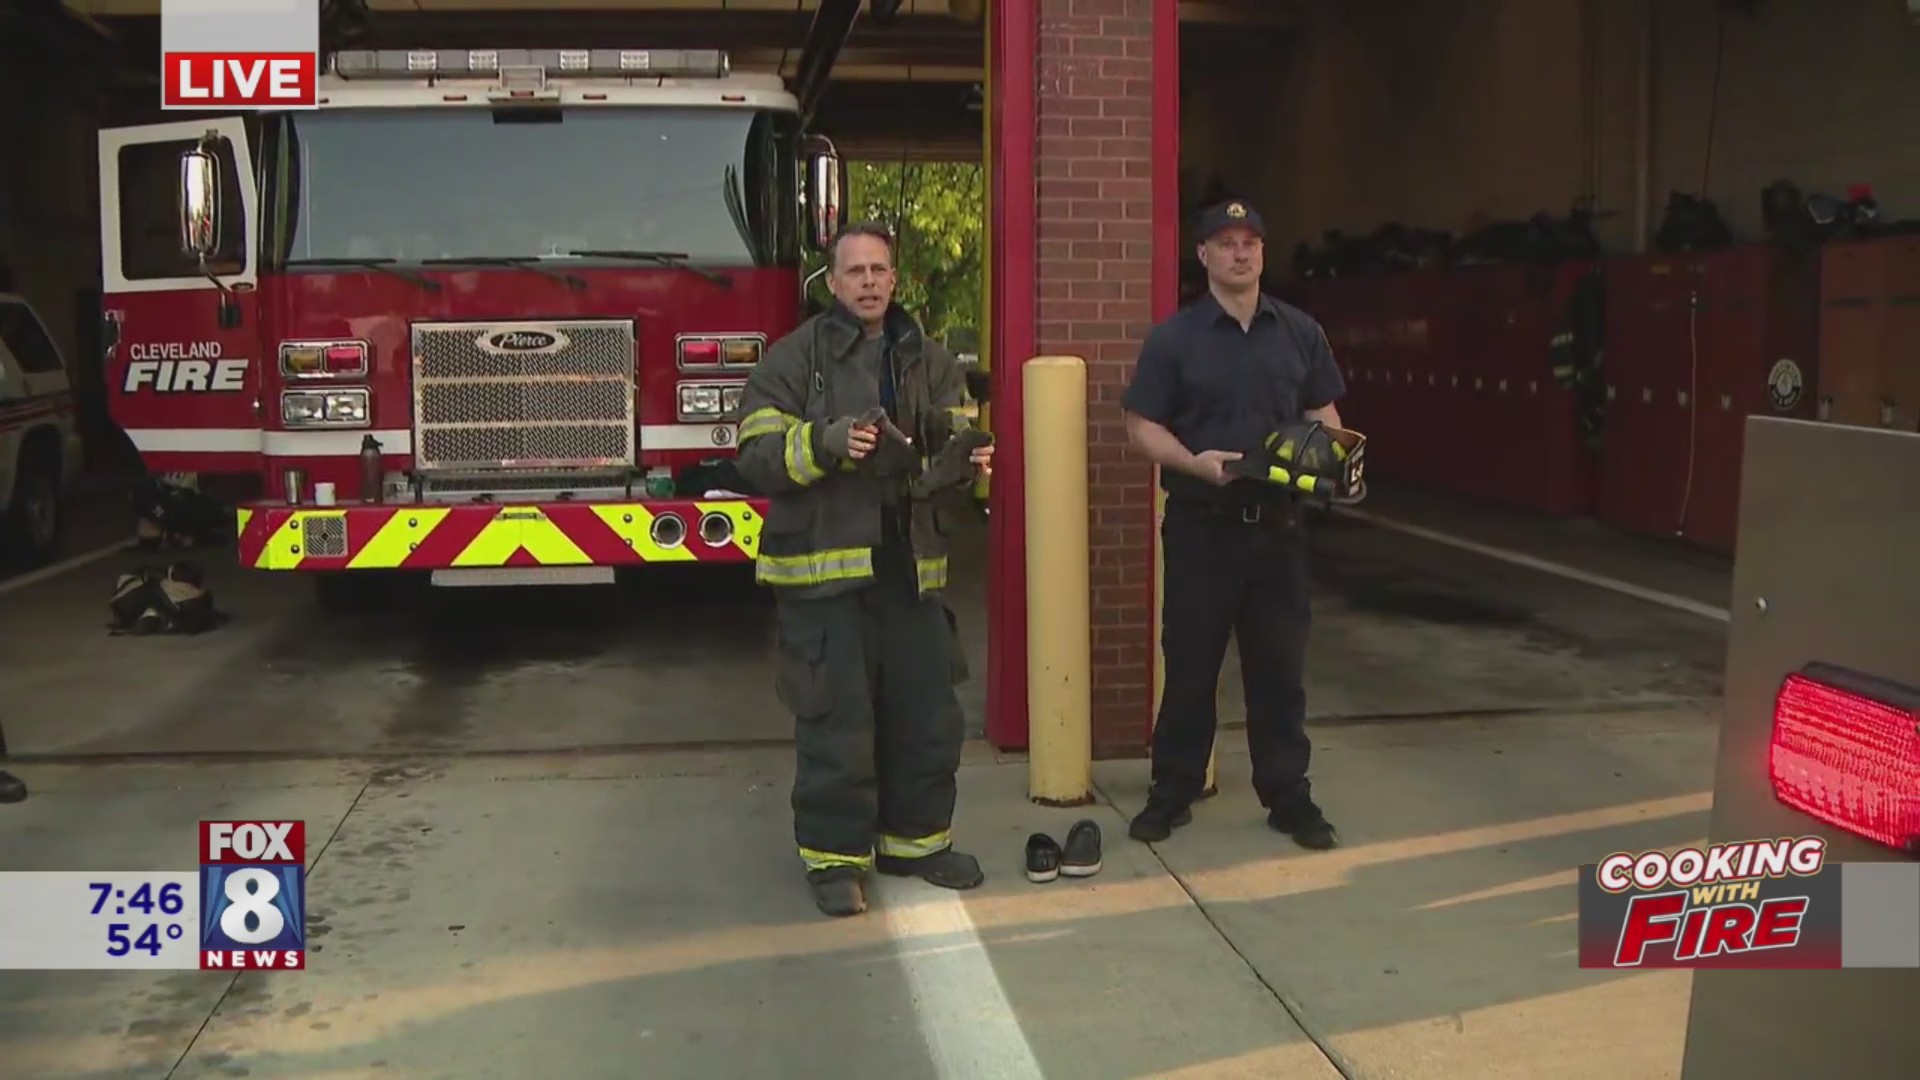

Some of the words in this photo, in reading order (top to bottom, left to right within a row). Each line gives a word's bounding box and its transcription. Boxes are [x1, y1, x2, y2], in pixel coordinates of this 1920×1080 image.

[498, 332, 549, 349] Pierce
[130, 341, 222, 360] CLEVELAND
[124, 359, 249, 392] FIRE
